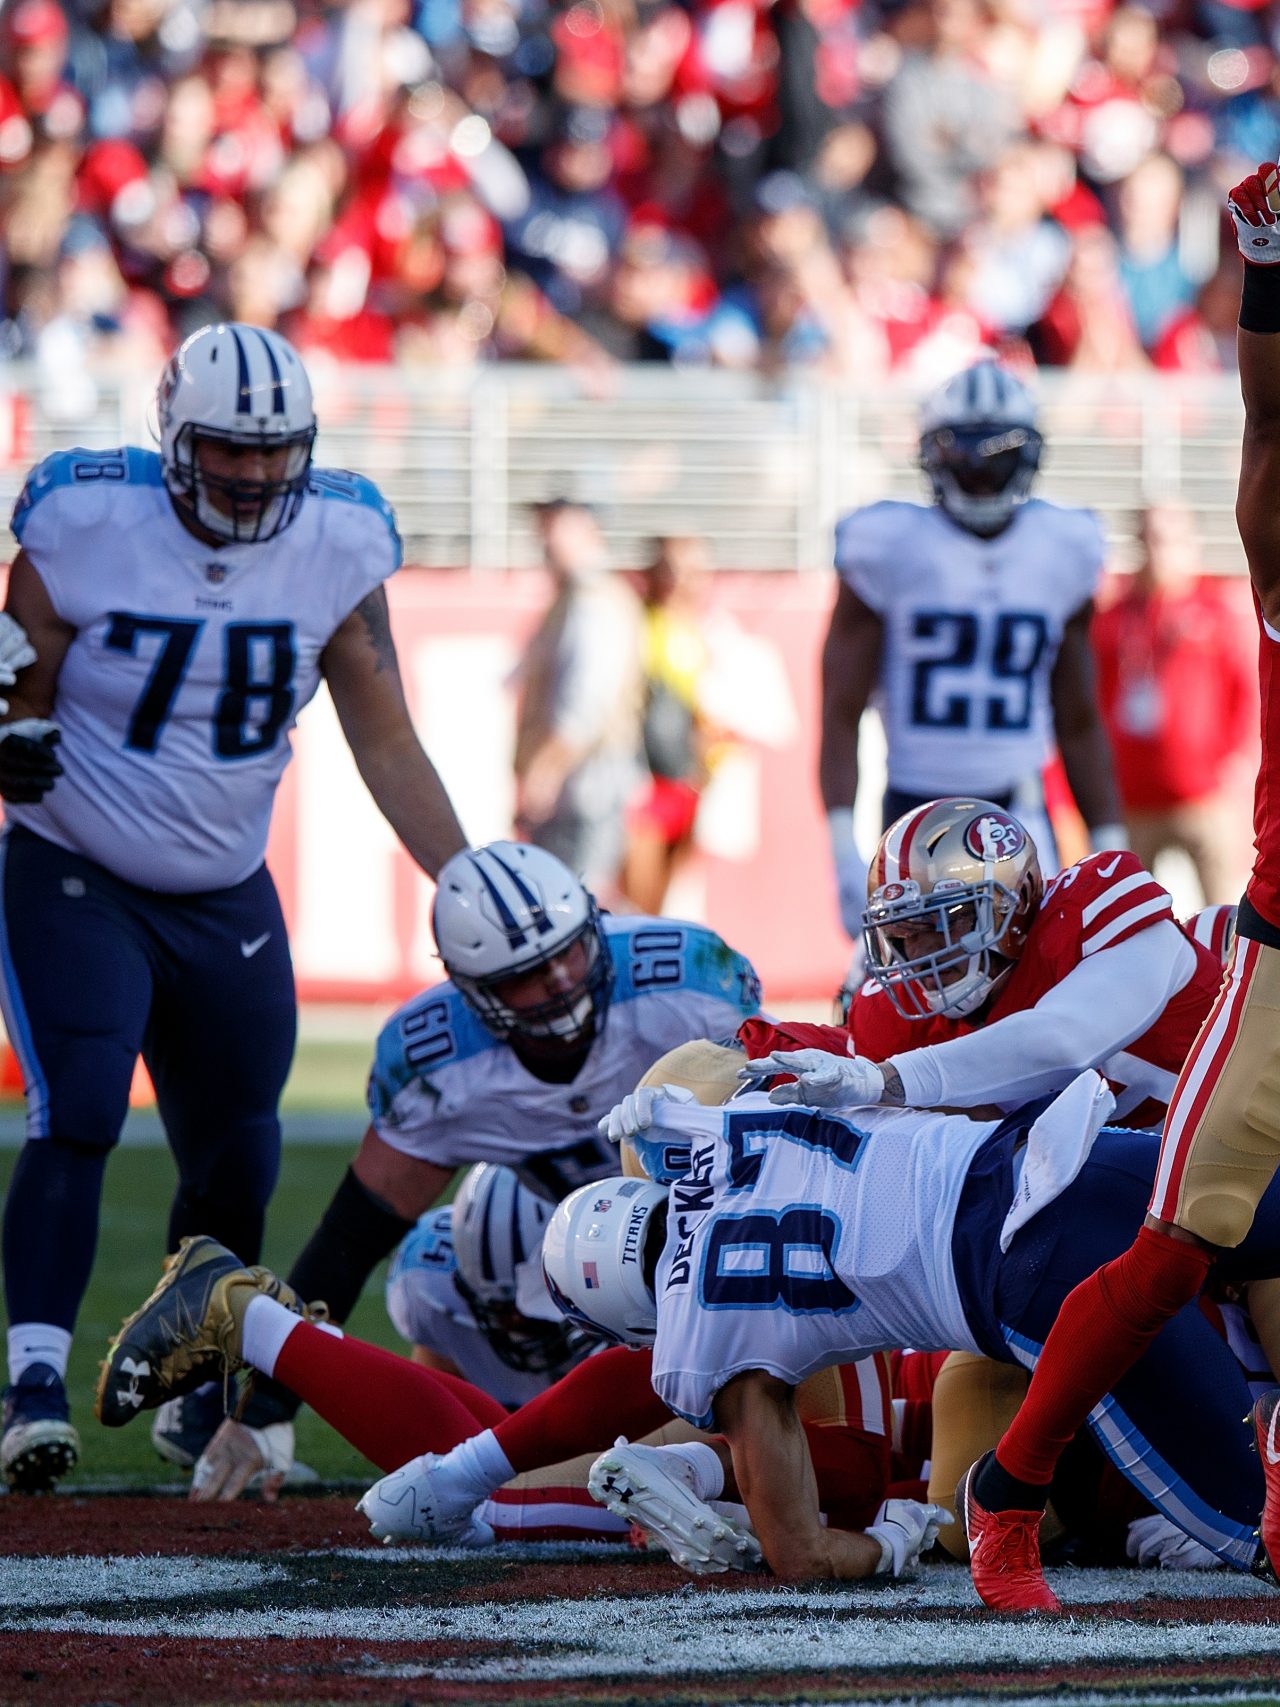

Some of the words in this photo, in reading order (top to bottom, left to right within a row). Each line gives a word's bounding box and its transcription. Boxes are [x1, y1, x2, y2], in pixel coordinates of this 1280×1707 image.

[104, 611, 297, 763] 78
[911, 610, 1048, 730] 29
[630, 929, 686, 988] 60
[403, 1001, 455, 1067] 60
[622, 1205, 649, 1265] TITANS
[665, 1142, 716, 1292] DECKER
[698, 1107, 872, 1317] 87
